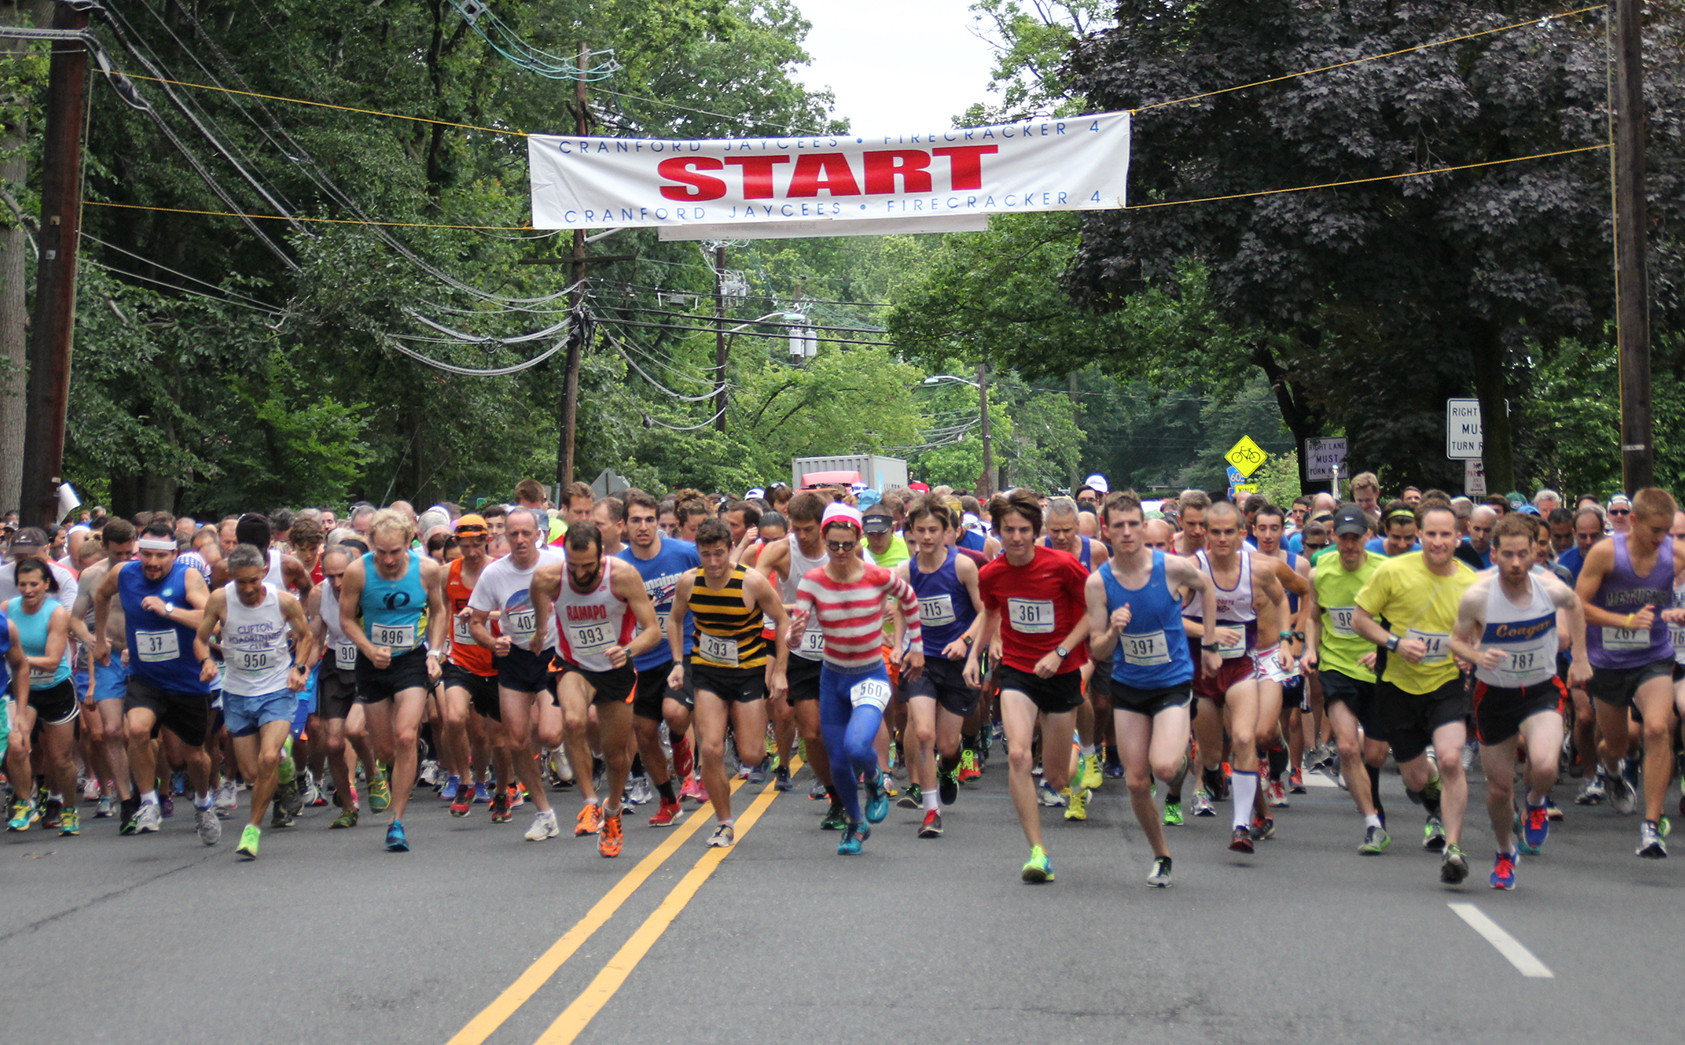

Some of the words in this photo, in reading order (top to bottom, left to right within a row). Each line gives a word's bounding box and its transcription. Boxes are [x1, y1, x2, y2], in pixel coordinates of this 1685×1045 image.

[559, 141, 701, 154] CRANFORD
[724, 136, 838, 151] JAYCEES
[884, 122, 1067, 145] FIRECRACKER
[1089, 120, 1100, 133] 4
[657, 144, 999, 202] START
[565, 207, 706, 223] CRANFORD
[728, 202, 841, 218] JAYCEES
[887, 191, 1068, 213] FIRECRACKER
[1091, 190, 1101, 203] 4
[1451, 407, 1478, 417] RIGHT
[1329, 442, 1346, 450] LANE
[1452, 441, 1475, 451] TURN
[1316, 454, 1339, 463] MUST
[566, 604, 608, 621] RAMAPO
[922, 602, 942, 617] 715
[1019, 604, 1041, 621] 361
[1338, 611, 1352, 626] 98
[237, 621, 273, 634] CLIFTON
[149, 636, 162, 651] 37
[381, 629, 404, 645] 896
[578, 627, 604, 645] 993
[809, 634, 824, 650] 92
[341, 646, 355, 661] 90
[707, 639, 727, 656] 293
[1130, 639, 1154, 655] 397
[243, 653, 267, 668] 950
[1510, 653, 1534, 669] 787
[860, 682, 883, 698] 560
